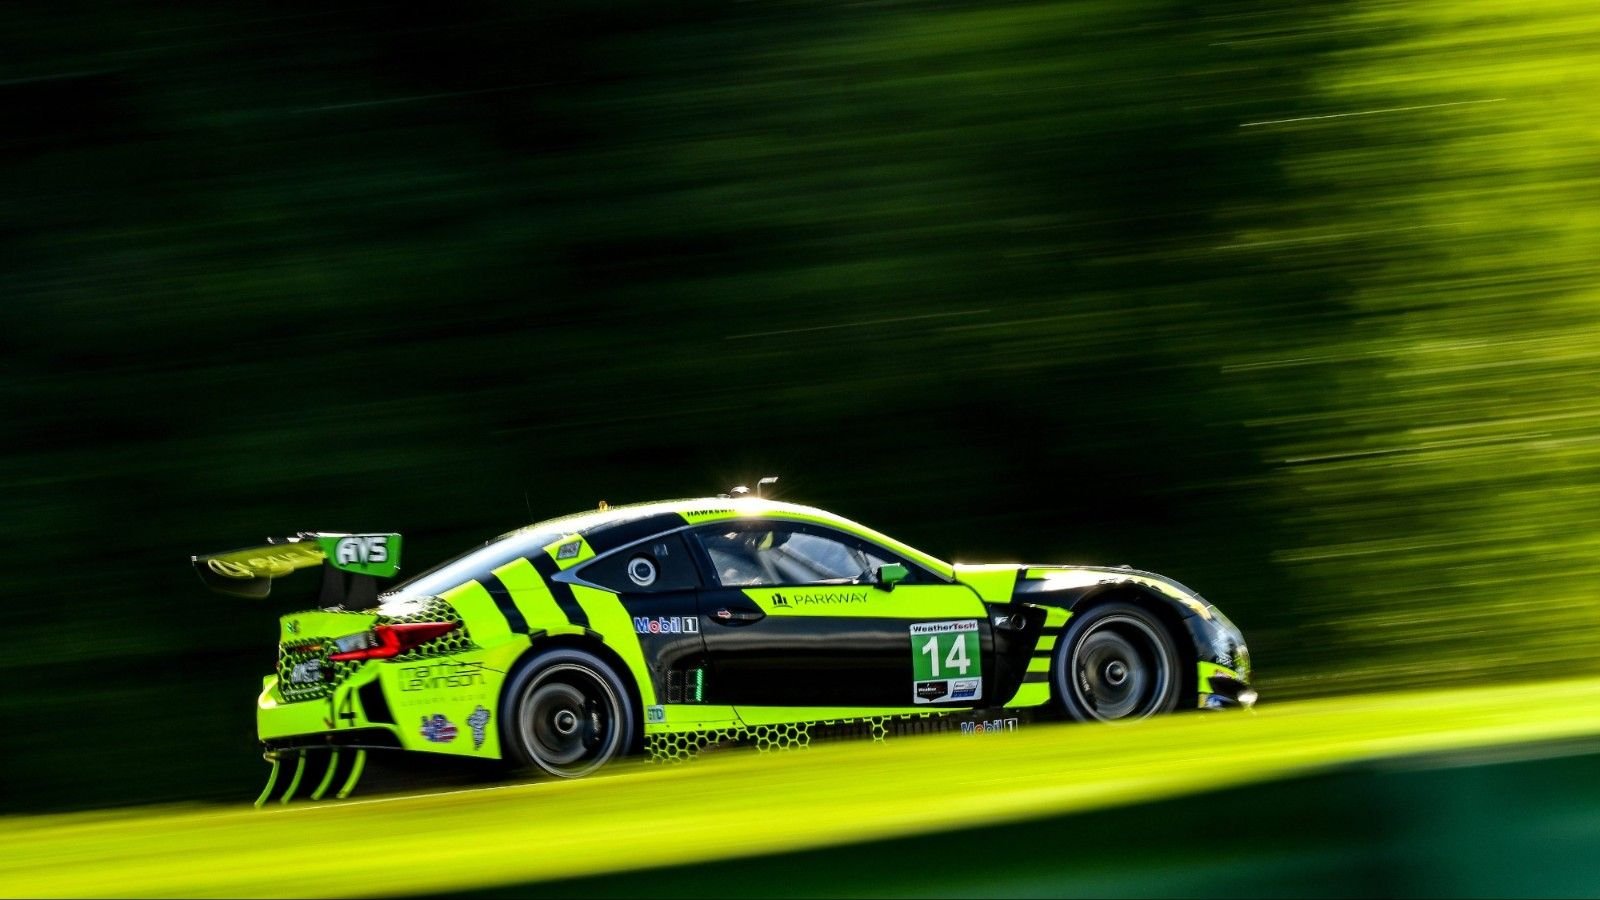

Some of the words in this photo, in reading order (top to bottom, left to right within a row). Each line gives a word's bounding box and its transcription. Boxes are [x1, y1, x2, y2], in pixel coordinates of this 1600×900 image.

[794, 592, 868, 605] PARKWAY
[633, 616, 681, 634] Mobil
[682, 616, 699, 634] 1
[922, 634, 971, 677] 14
[960, 719, 1002, 736] Mobil
